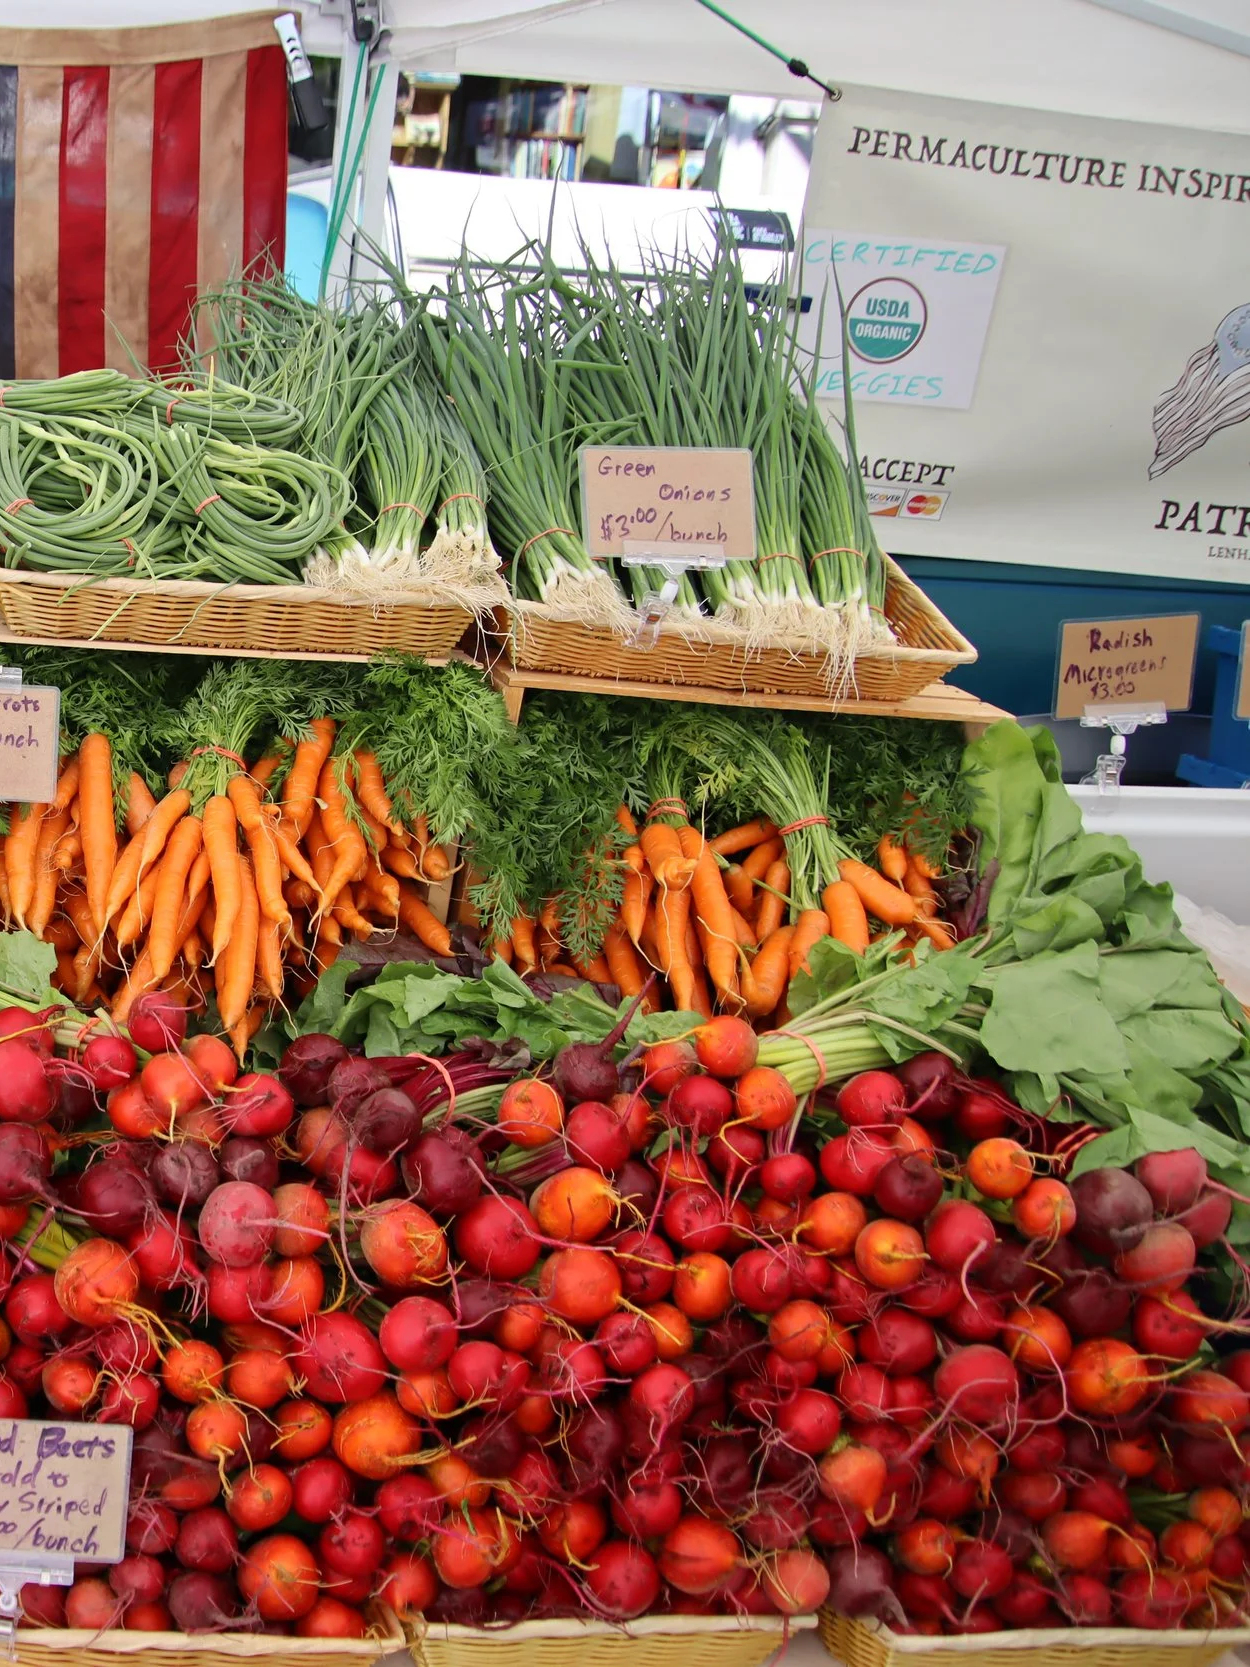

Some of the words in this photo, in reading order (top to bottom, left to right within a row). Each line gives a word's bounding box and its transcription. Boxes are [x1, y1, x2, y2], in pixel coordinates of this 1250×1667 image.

[847, 126, 1127, 188] PERMACULTURE
[804, 240, 997, 275] CERTIFIED
[865, 297, 910, 318] USDA
[855, 322, 912, 341] ORGANIC
[598, 456, 656, 478] Green
[860, 455, 955, 486] ACCEPT
[659, 484, 731, 501] Onions
[1207, 546, 1250, 561] LENH
[1090, 628, 1153, 653] Radish
[1063, 656, 1167, 685] Microgreens
[1091, 681, 1135, 699] $3.00
[37, 1425, 116, 1459] Beets
[18, 1489, 108, 1522] Striped
